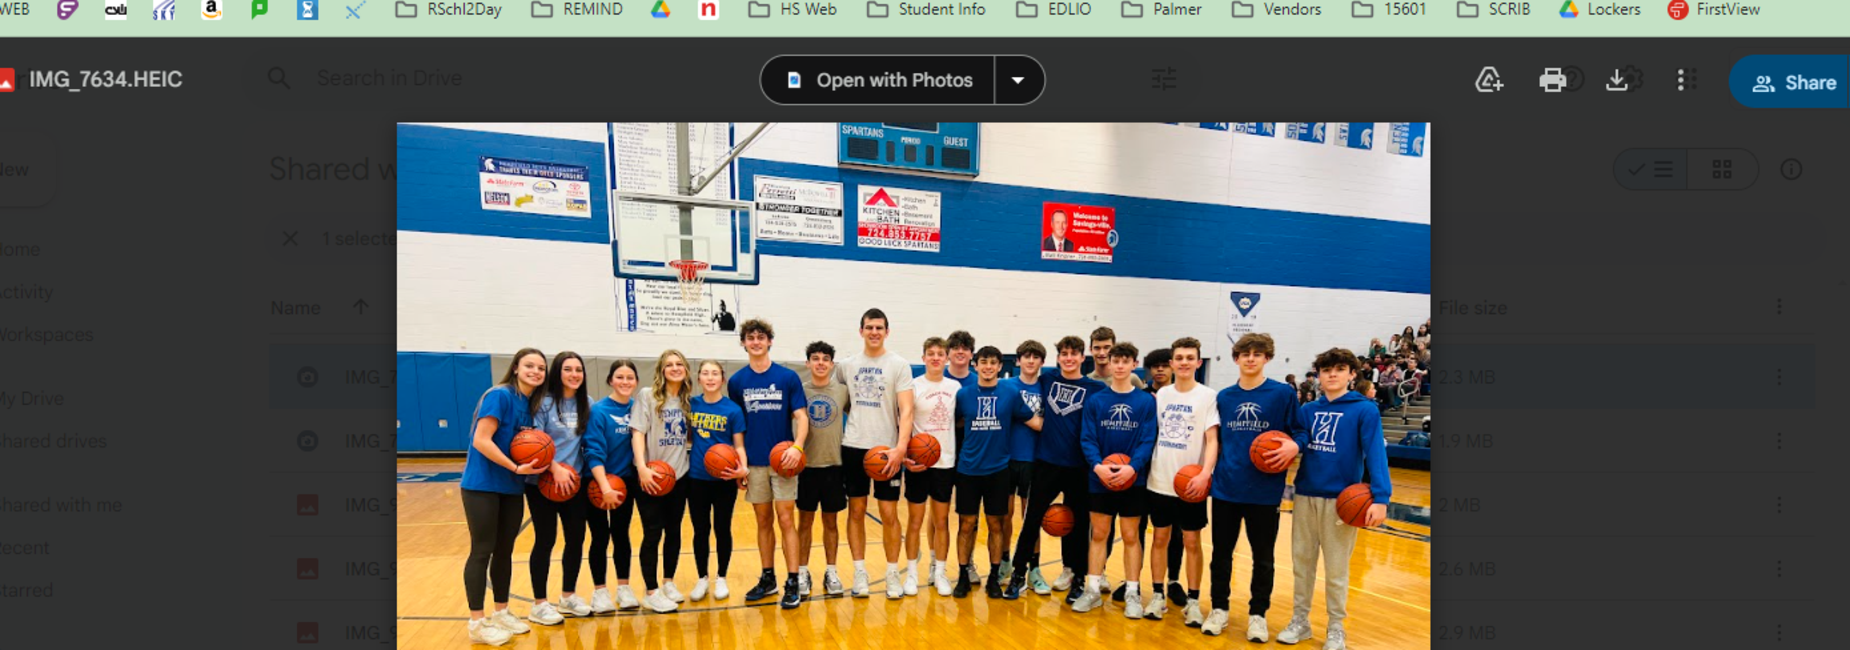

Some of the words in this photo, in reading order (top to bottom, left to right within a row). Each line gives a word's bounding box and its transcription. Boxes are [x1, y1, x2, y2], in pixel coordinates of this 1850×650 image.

[0, 3, 29, 15] WEB
[429, 2, 502, 19] RSchl2Day
[565, 3, 622, 15] REMIND
[782, 2, 799, 15] HS
[806, 2, 836, 15] Web
[900, 2, 954, 15] Student
[959, 2, 985, 15] Info
[1049, 3, 1091, 15] EDLIO
[1155, 2, 1202, 15] Palmer
[1264, 2, 1321, 15] Vendors
[1385, 2, 1425, 15] 15601
[1490, 2, 1530, 15] SCRIB
[1589, 2, 1641, 15] Lockers
[1698, 2, 1760, 15] FirstView
[30, 70, 183, 92] IMG_7634.HEIC
[318, 69, 385, 86] Search
[391, 69, 407, 86] in
[415, 69, 462, 86] Drive
[817, 72, 864, 91] Open
[870, 72, 907, 88] with
[913, 72, 973, 88] Photos
[1786, 74, 1837, 90] Share
[842, 125, 884, 138] SPARTANS
[943, 136, 968, 147] GUEST
[270, 157, 369, 181] Shared
[863, 207, 900, 217] KITCHEN
[877, 216, 900, 224] BATH
[323, 232, 328, 245] 1
[859, 237, 882, 245] GOOD
[884, 239, 902, 247] LUCK
[0, 242, 41, 257] ome
[272, 301, 322, 315] Name
[1439, 300, 1468, 315] File
[1474, 300, 1507, 315] size
[1439, 370, 1463, 385] 2.3
[1469, 370, 1495, 385] MB
[22, 391, 64, 406] Drive
[1100, 419, 1139, 428] HEMPFIELD
[1226, 420, 1270, 428] HEMPFIELD
[0, 433, 50, 449] hared
[57, 433, 107, 449] drives
[1439, 434, 1461, 448] 1.9
[1467, 434, 1493, 448] MB
[0, 497, 50, 513] hared
[56, 497, 91, 513] with
[97, 501, 121, 513] me
[1439, 498, 1448, 512] 2
[1454, 498, 1480, 512] MB
[0, 541, 49, 555] ecent
[1439, 562, 1463, 576] 2.6
[1470, 562, 1496, 576] MB
[0, 582, 53, 598] tarred
[1439, 626, 1463, 640] 2.9
[1470, 626, 1496, 640] MB
